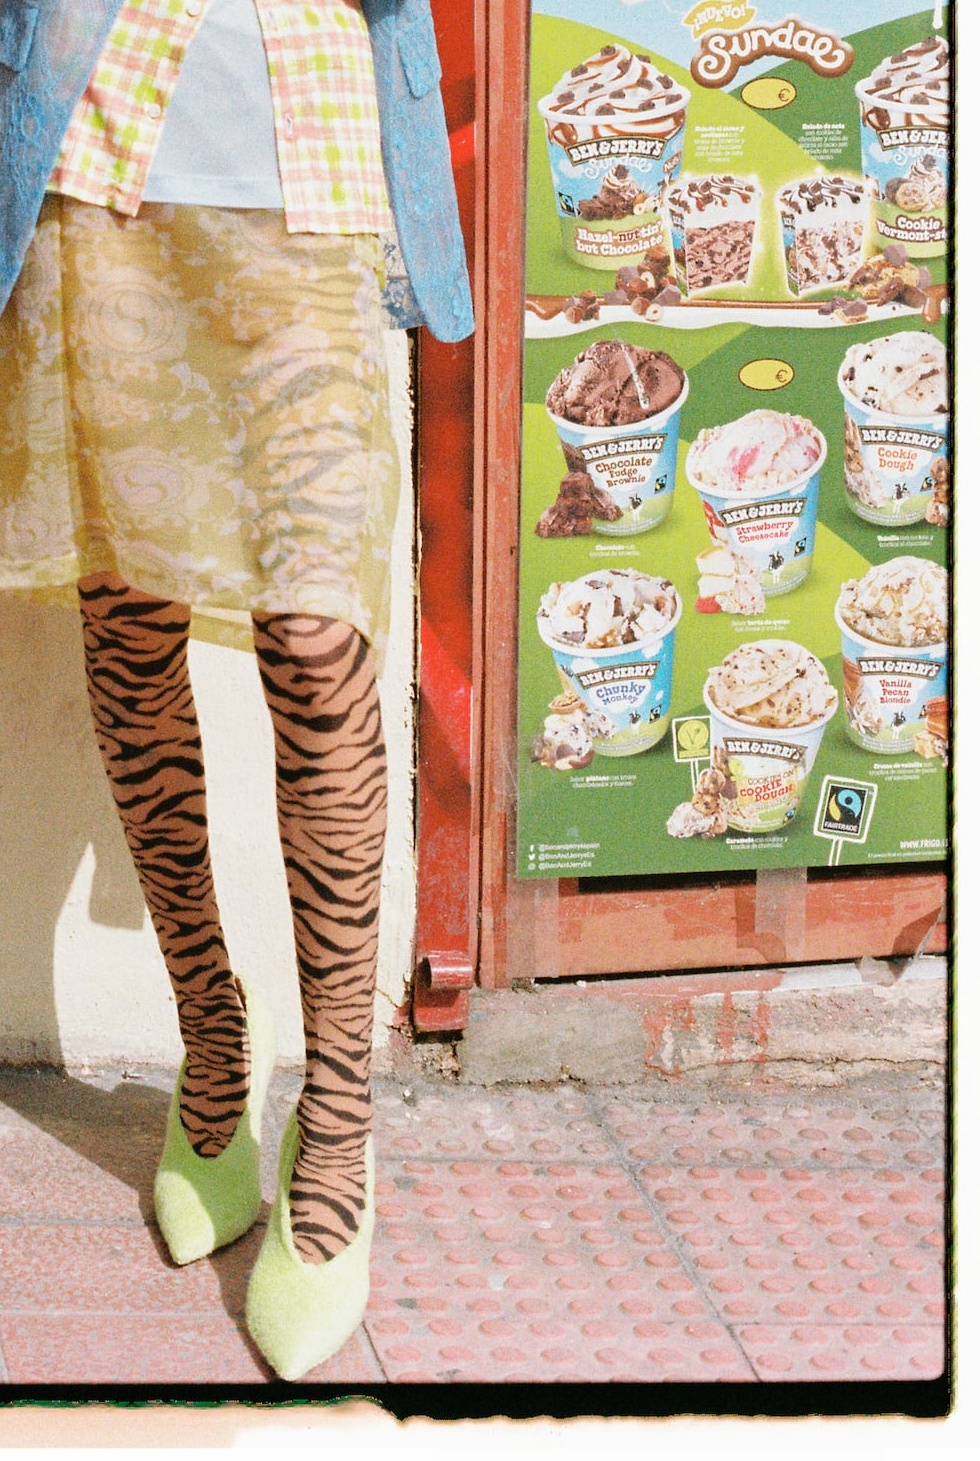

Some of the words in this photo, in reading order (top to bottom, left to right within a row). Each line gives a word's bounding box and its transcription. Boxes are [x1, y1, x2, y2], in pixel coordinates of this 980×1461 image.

[698, 22, 845, 80] Sundae
[897, 217, 941, 230] Cookie
[600, 235, 663, 256] Chocolate
[878, 447, 917, 460] Cookie
[595, 457, 653, 473] Chocolate
[879, 458, 914, 472] Dough
[609, 467, 637, 478] Fudge
[606, 475, 646, 487] Brownie
[736, 521, 794, 536] Strawberry
[739, 531, 789, 544] Cheesecake
[596, 682, 646, 698] Chunky
[879, 679, 912, 688] Vanilla
[882, 688, 909, 696] Pecan
[602, 693, 638, 705] Monkey
[740, 780, 782, 797] COOKIE
[755, 784, 793, 802] DOUGH
